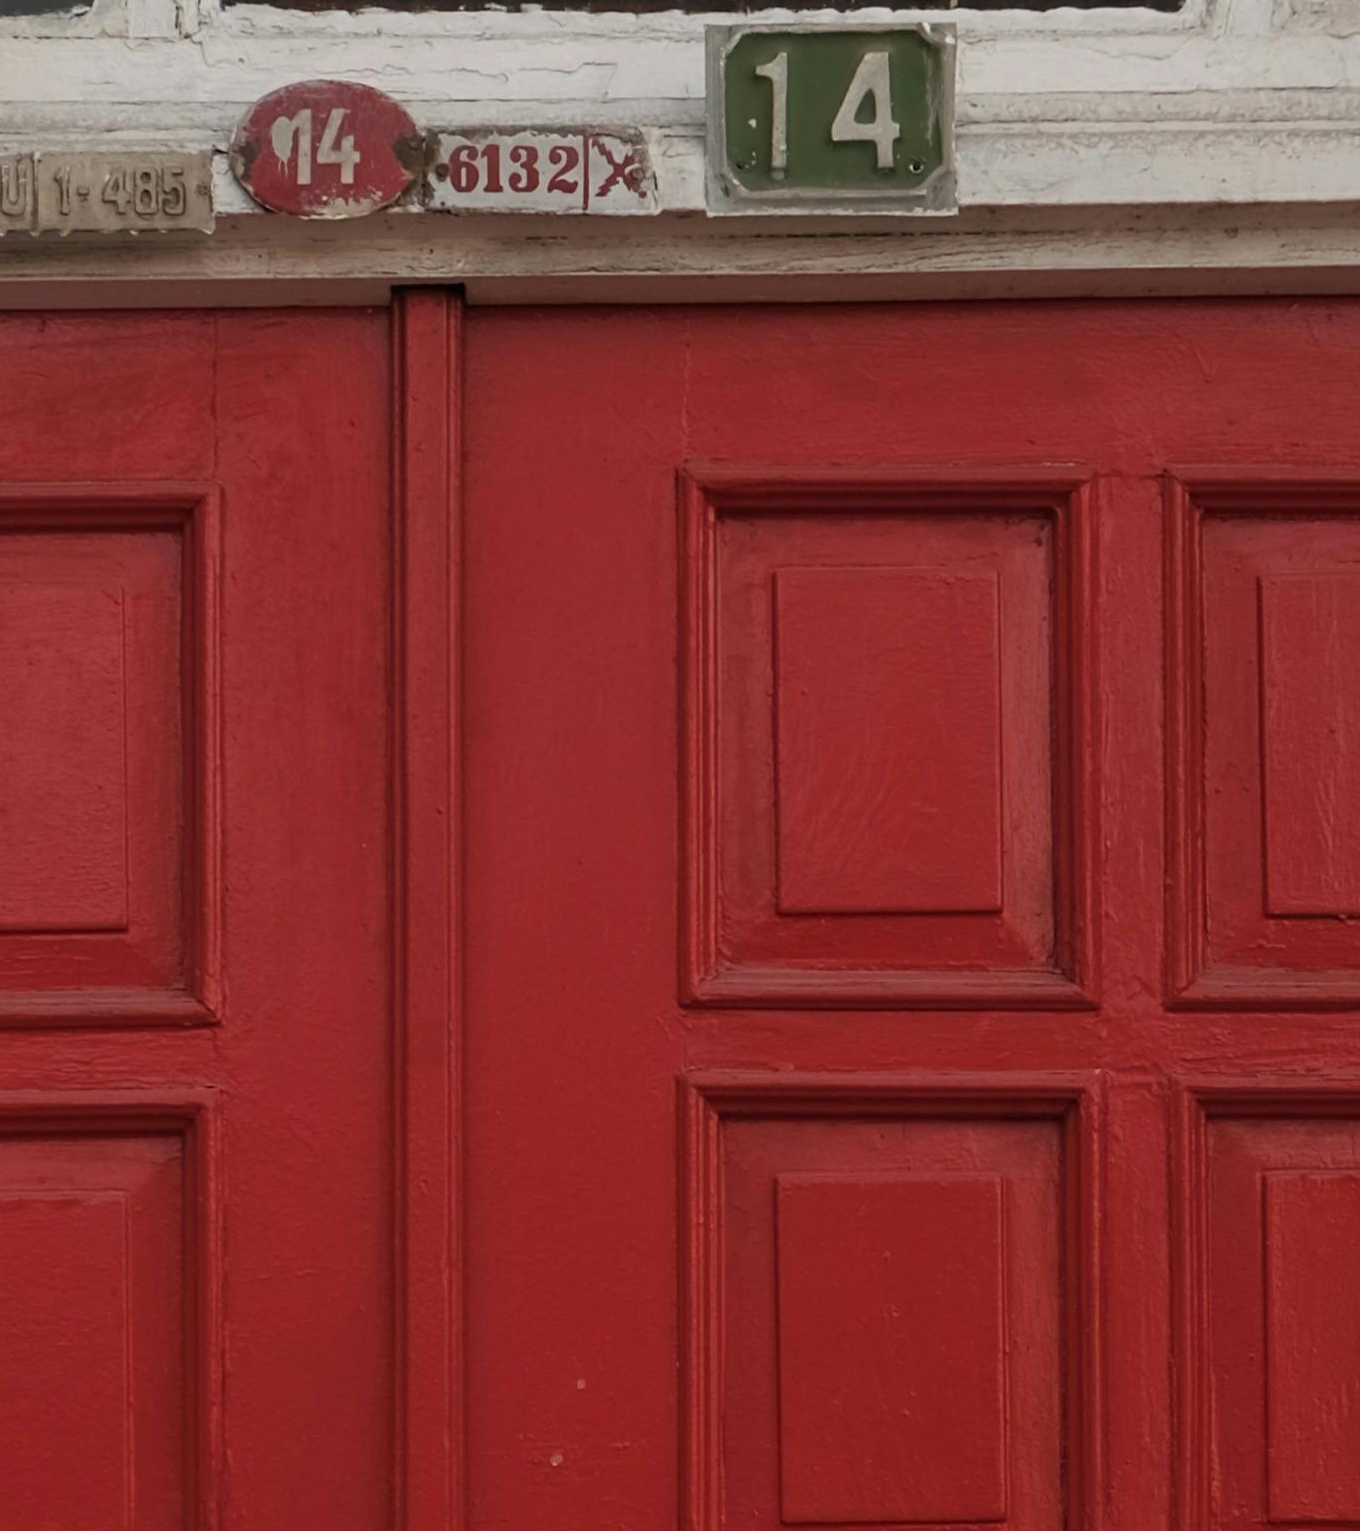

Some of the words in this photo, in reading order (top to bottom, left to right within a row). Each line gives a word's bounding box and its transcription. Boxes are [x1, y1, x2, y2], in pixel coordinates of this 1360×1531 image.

[291, 108, 361, 185] 14
[755, 51, 901, 169] 14
[449, 143, 579, 194] 6132
